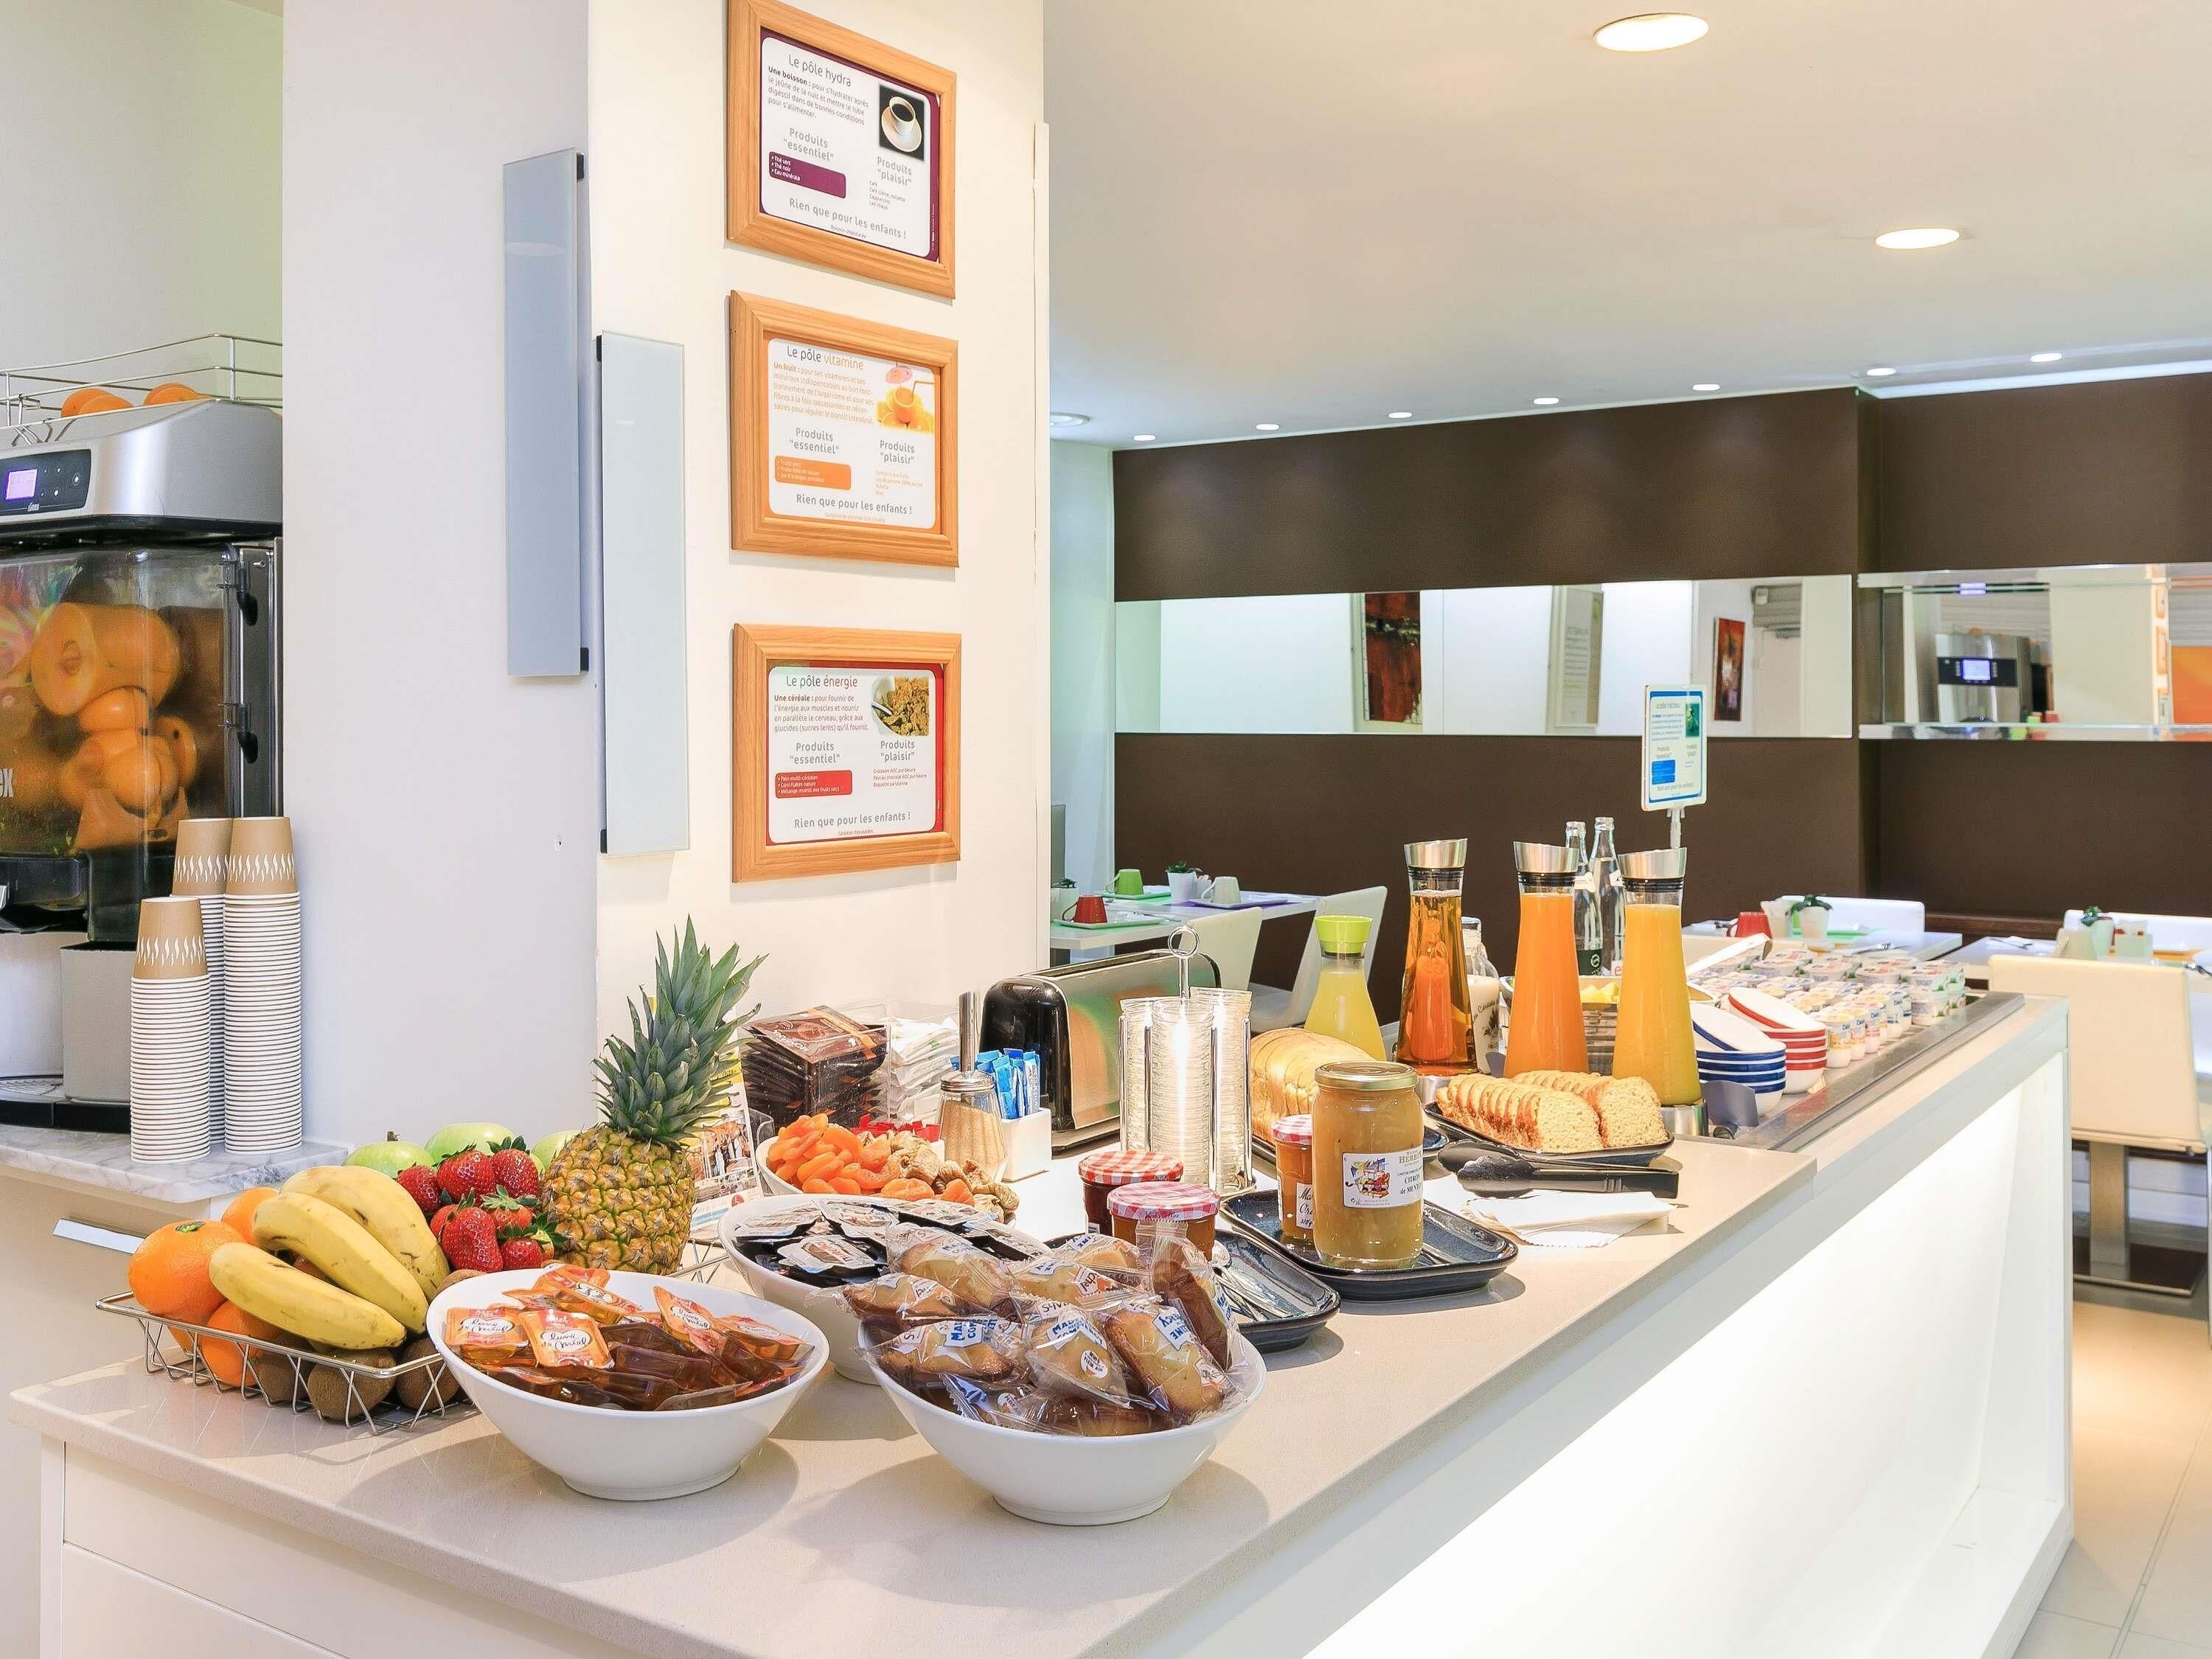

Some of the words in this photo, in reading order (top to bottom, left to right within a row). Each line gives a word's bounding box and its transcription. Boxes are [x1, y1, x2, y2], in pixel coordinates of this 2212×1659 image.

[789, 54, 799, 67] Le
[802, 61, 823, 77] pôle
[826, 68, 851, 86] hydra
[768, 66, 781, 76] Une
[783, 71, 807, 85] boisson
[813, 83, 824, 92] pour
[827, 87, 852, 102] s'hydrater
[855, 97, 869, 108] après
[768, 97, 782, 106] pour
[775, 79, 791, 89] jeûne
[793, 84, 799, 93] de
[808, 91, 818, 100] nuit
[827, 97, 844, 109] mettre
[852, 105, 864, 116] tube
[768, 87, 790, 99] digestif
[792, 94, 805, 105] dans
[807, 100, 813, 108] de
[815, 102, 835, 115] bonnes
[836, 111, 864, 125] conditions
[790, 128, 828, 147] Produits
[783, 138, 834, 161] "essentiel"
[877, 157, 911, 175] Produits
[877, 168, 912, 186] "plaisir"
[790, 198, 810, 212] Rien
[813, 206, 830, 217] que
[832, 210, 852, 224] pour
[855, 215, 868, 228] les
[870, 223, 901, 239] enfants
[787, 345, 798, 358] Le
[801, 348, 821, 362] pôle
[824, 353, 863, 370] vitamine
[774, 361, 782, 369] Un
[784, 364, 797, 372] fruit
[796, 428, 833, 442] Produits
[790, 439, 839, 454] "essentiel"
[880, 440, 914, 453] Produits
[880, 452, 914, 464] "plaisir"
[796, 494, 816, 505] Rien
[819, 497, 835, 507] que
[838, 500, 858, 509] pour
[860, 501, 873, 510] les
[876, 503, 907, 514] enfants
[786, 675, 796, 686] Le
[800, 675, 821, 689] pôle
[824, 675, 858, 689] énergie
[839, 714, 852, 722] grâce
[774, 725, 798, 733] glucides
[800, 724, 819, 732] (sucres
[820, 723, 836, 731] lents)
[796, 742, 834, 751] Produits
[880, 740, 914, 749] Produits
[790, 754, 840, 764] "essentiel"
[880, 751, 914, 762] "plaisir"
[794, 818, 815, 828] Rien
[818, 818, 834, 828] que
[837, 816, 857, 827] pour
[860, 814, 872, 823] les
[874, 813, 905, 821] enfants
